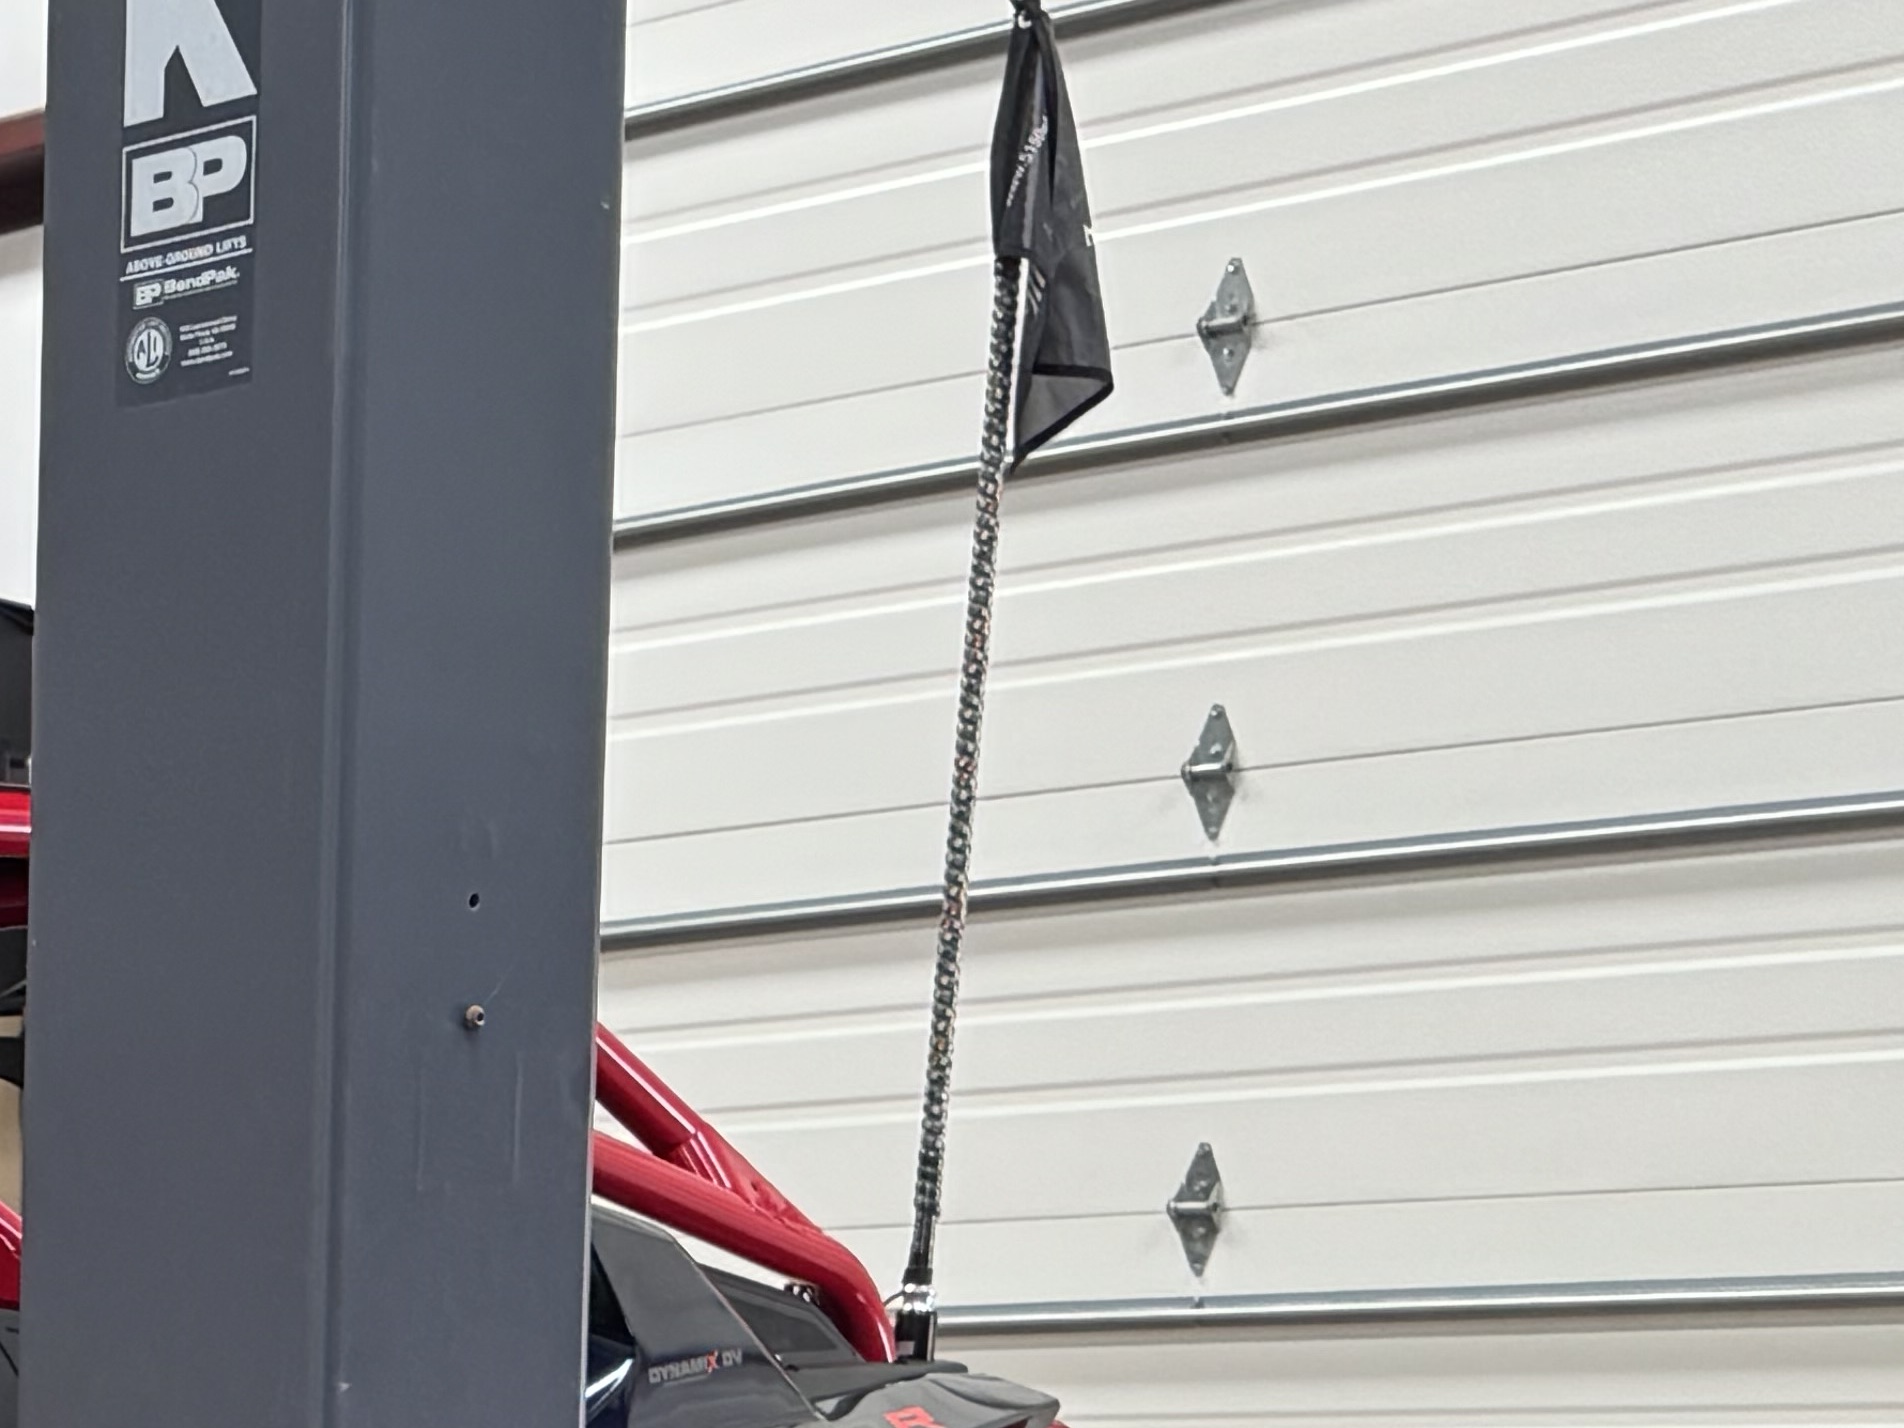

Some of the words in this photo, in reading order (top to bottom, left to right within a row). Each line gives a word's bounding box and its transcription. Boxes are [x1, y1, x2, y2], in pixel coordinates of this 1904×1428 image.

[130, 135, 248, 237] BP
[135, 282, 162, 306] BP
[649, 1350, 719, 1383] DYNAMIX
